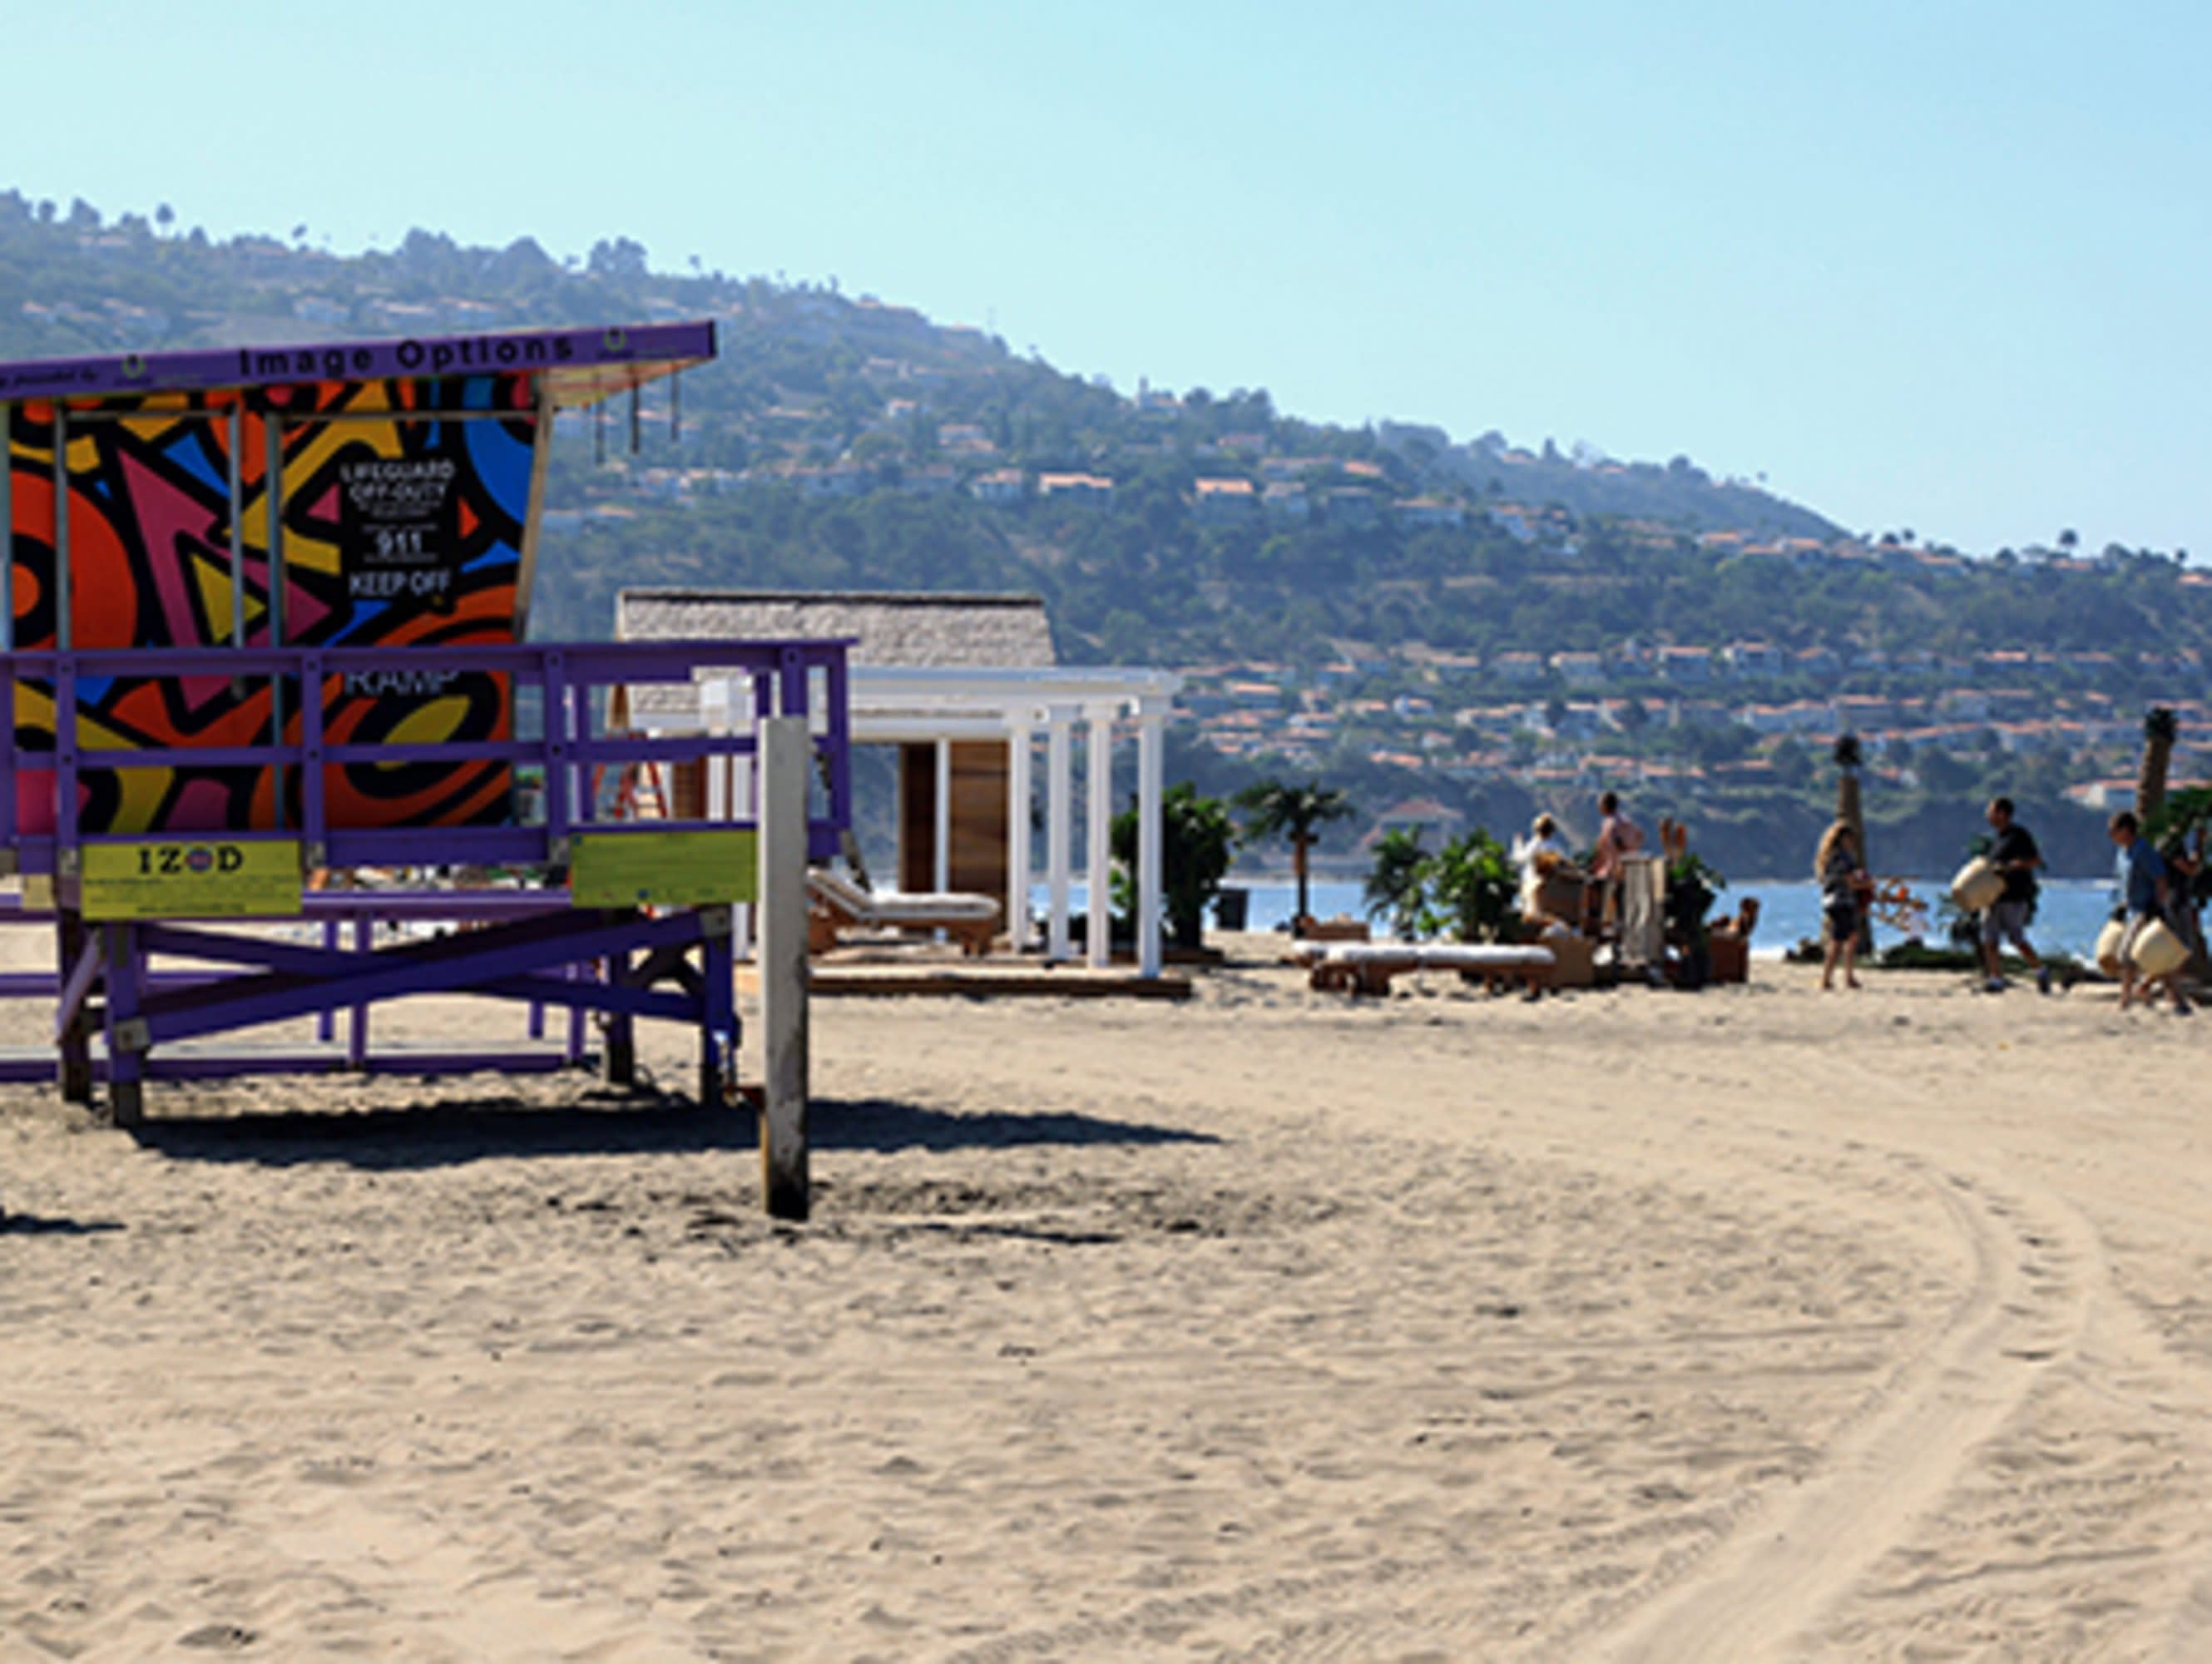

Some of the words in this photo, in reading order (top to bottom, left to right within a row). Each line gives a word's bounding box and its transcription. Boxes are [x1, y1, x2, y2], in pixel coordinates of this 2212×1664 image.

[240, 346, 374, 378] Image
[396, 336, 573, 371] Options
[339, 459, 455, 483] LIFEGUARD
[374, 531, 422, 557] 911
[349, 572, 406, 596] KEEP
[410, 571, 450, 594] OFF
[137, 844, 244, 874] IZOD
